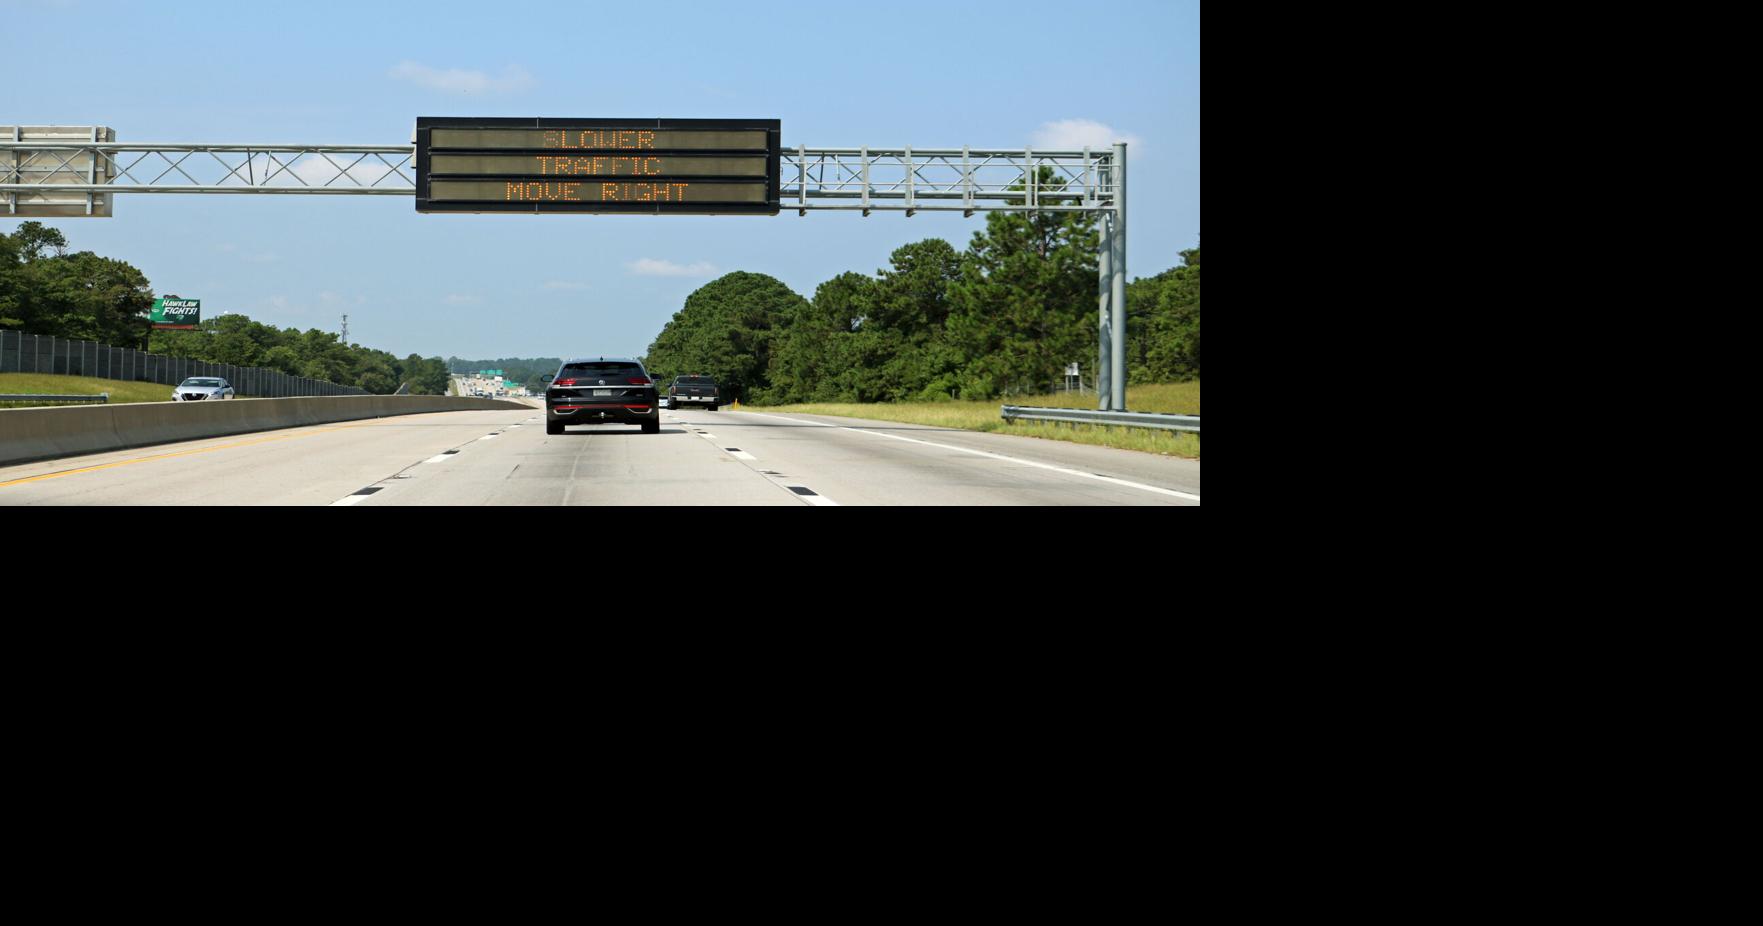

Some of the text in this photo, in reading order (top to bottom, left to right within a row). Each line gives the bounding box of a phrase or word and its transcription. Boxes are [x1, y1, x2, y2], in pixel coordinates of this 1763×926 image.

[543, 130, 656, 149] SLOWER
[537, 156, 662, 175] TRAFFIC
[506, 182, 689, 202] MOVE RIGHT
[162, 307, 198, 316] FIGHTS!
